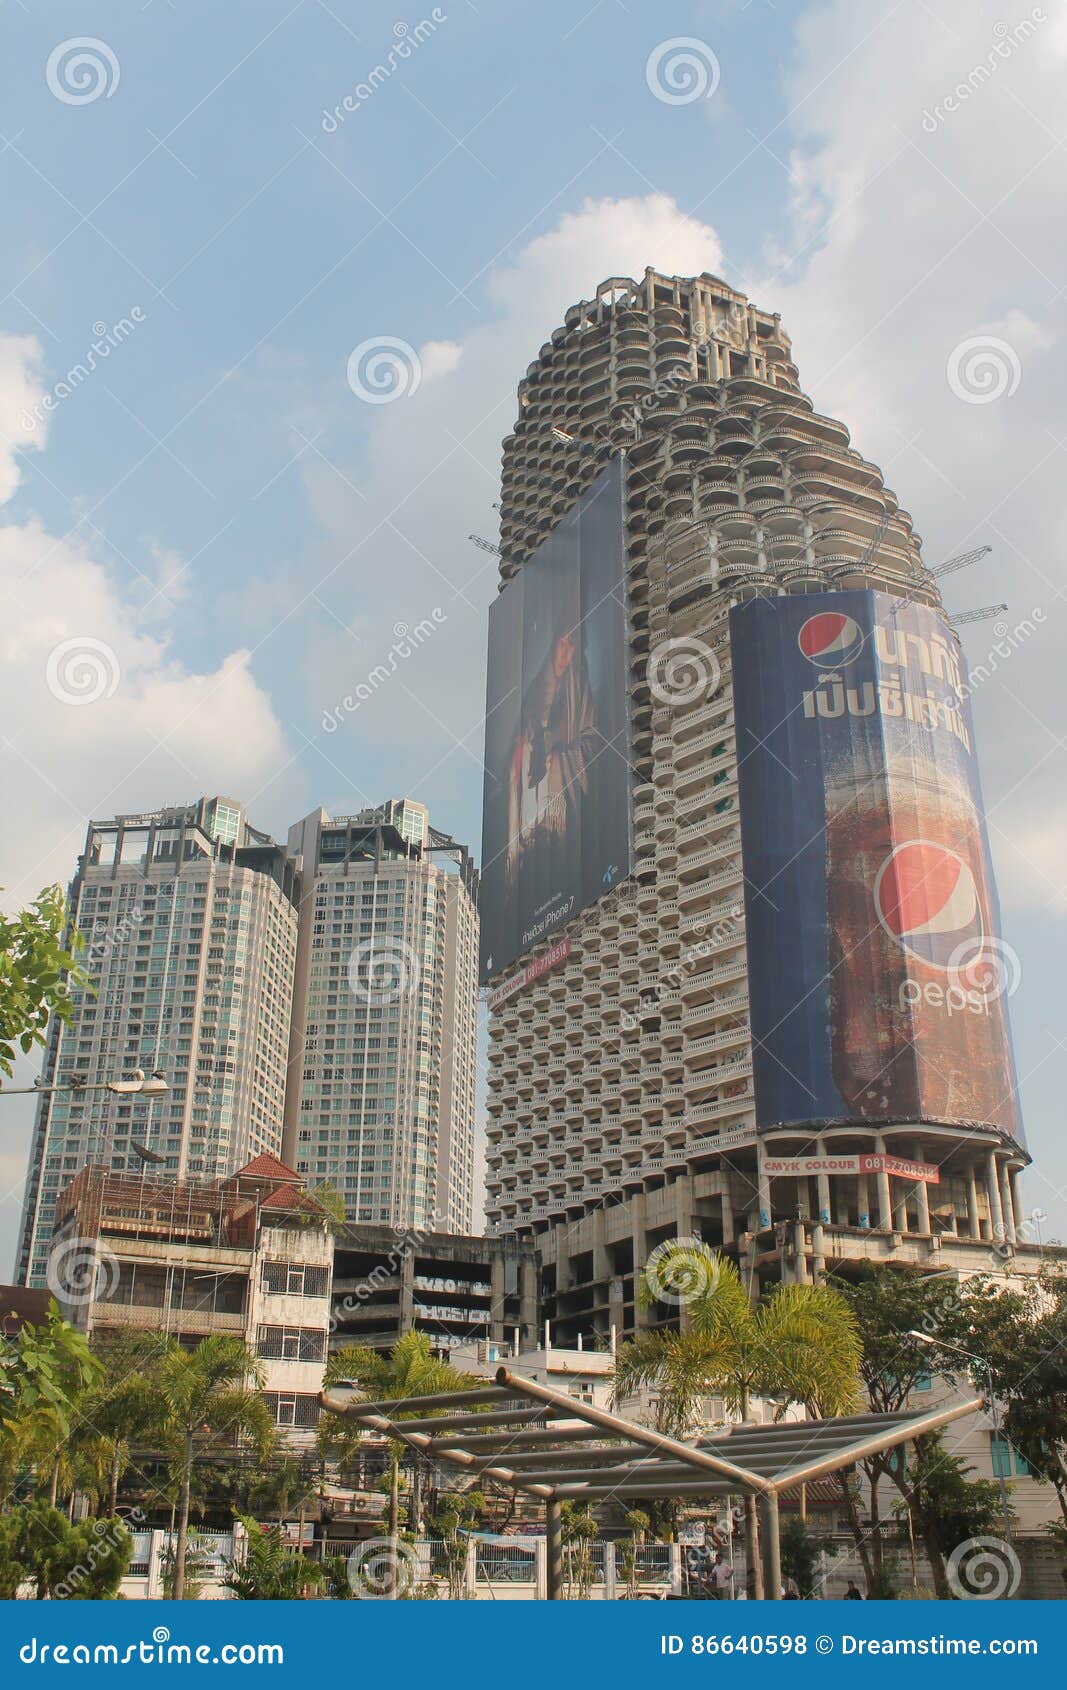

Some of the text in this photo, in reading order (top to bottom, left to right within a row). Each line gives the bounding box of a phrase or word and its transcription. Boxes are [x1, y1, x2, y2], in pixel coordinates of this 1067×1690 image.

[899, 979, 989, 1017] pepsi
[764, 1161, 800, 1173] CMYK
[805, 1159, 856, 1171] COLOUR
